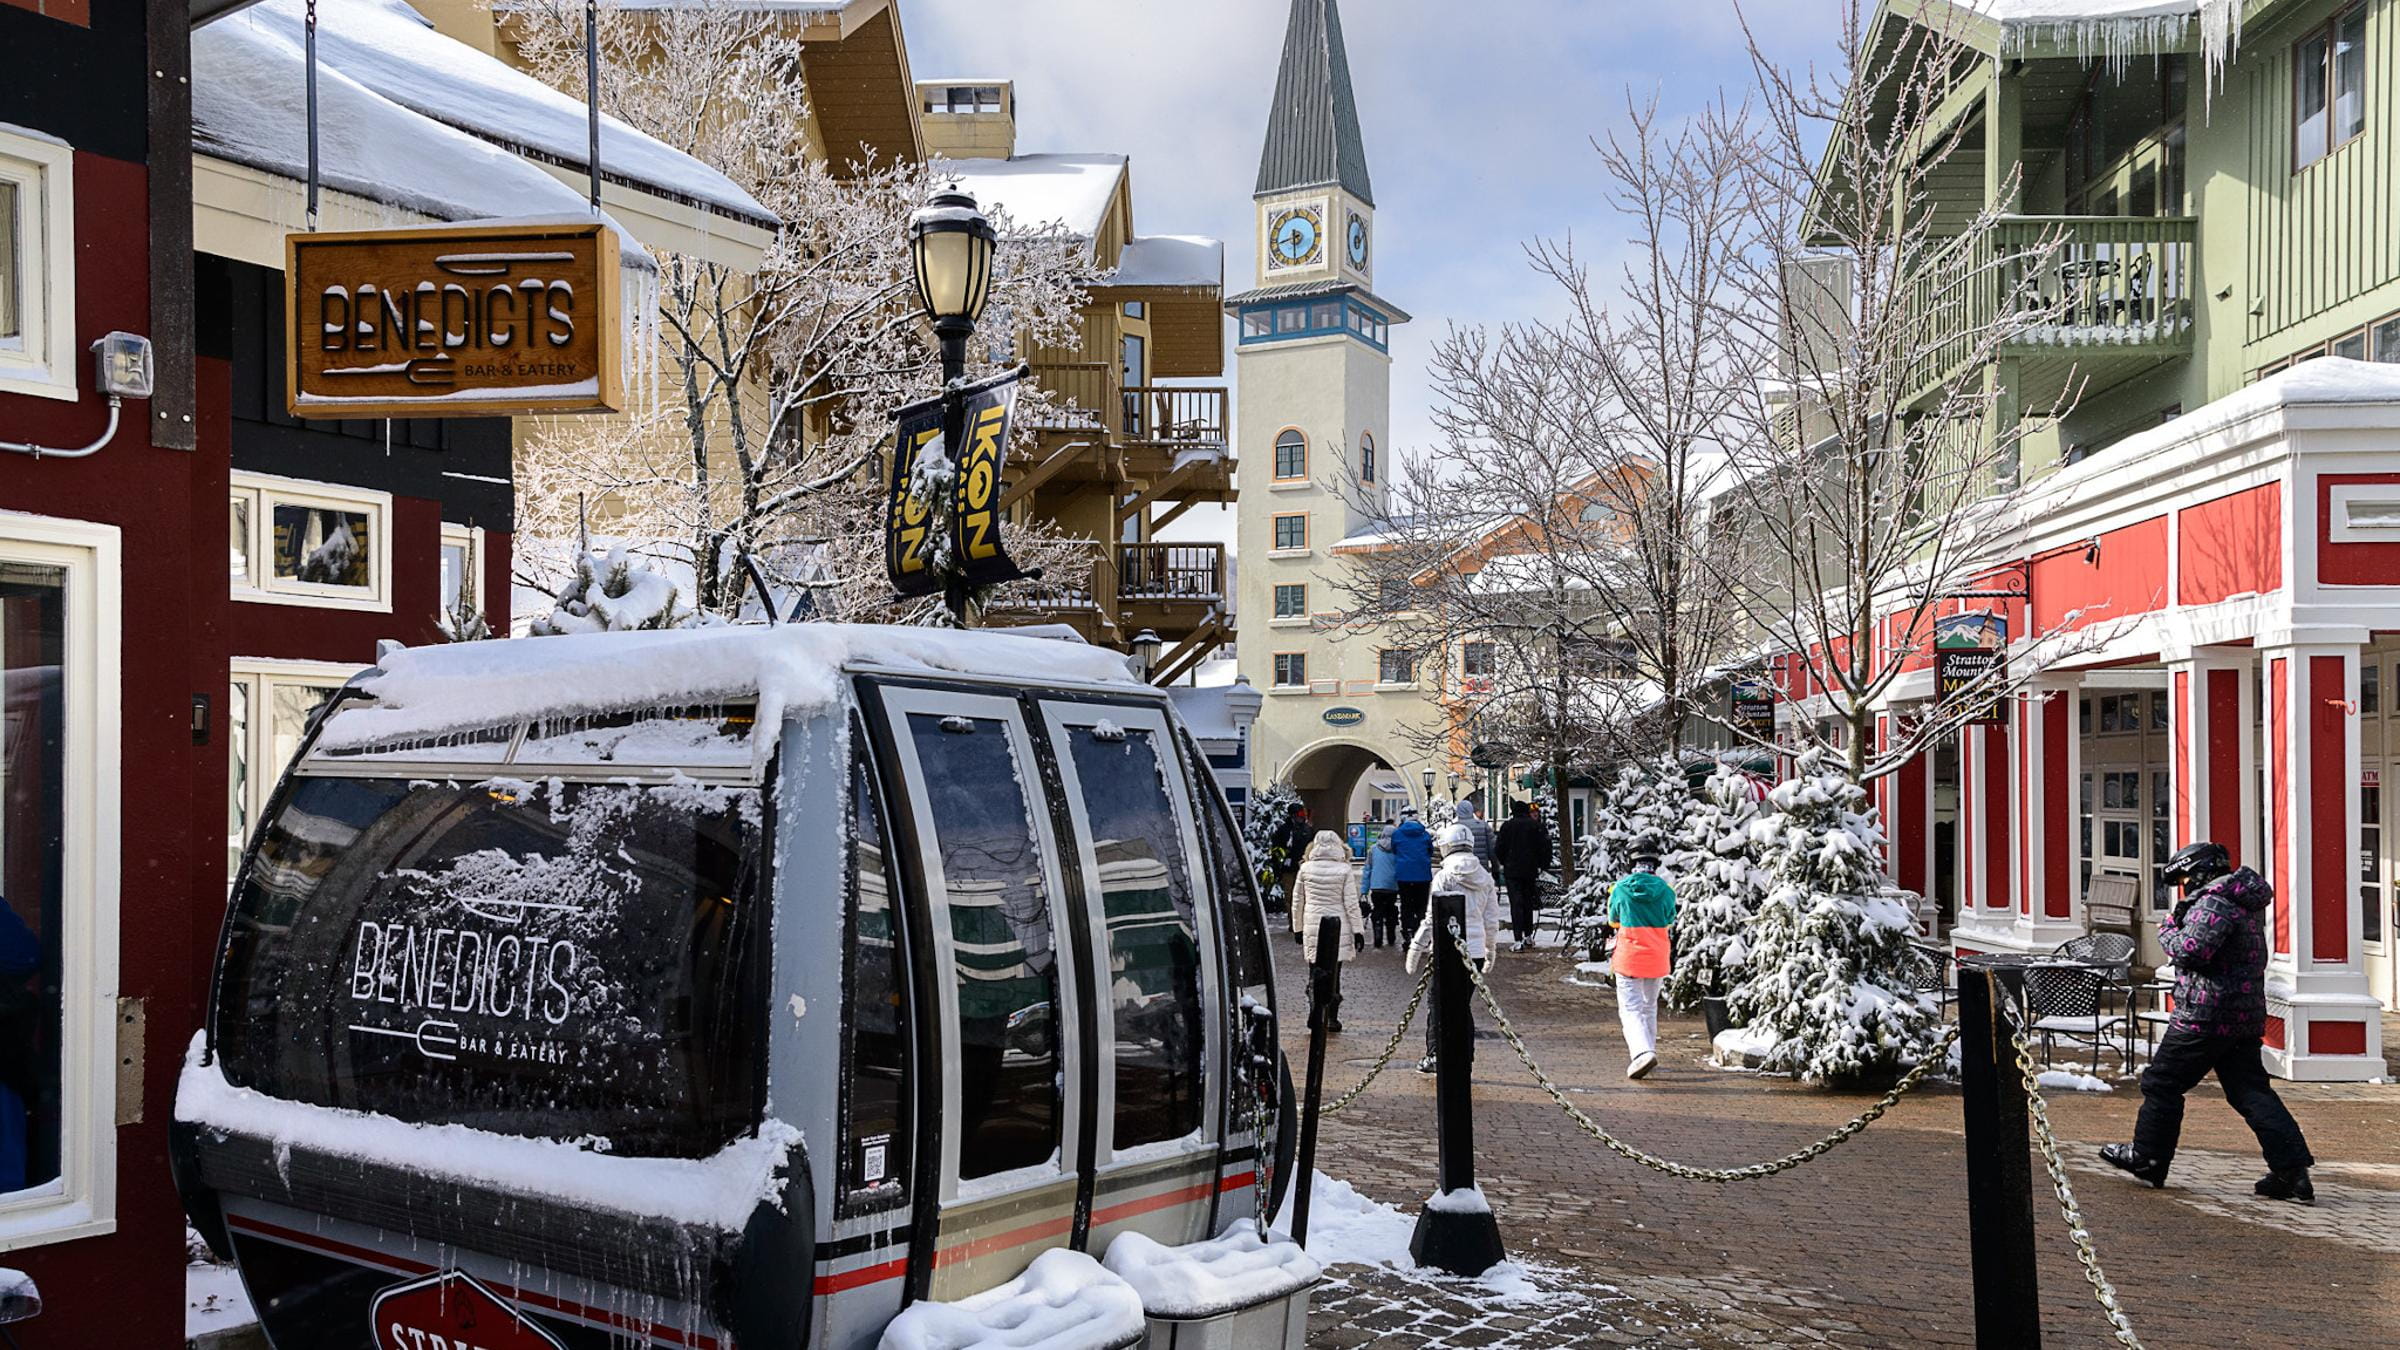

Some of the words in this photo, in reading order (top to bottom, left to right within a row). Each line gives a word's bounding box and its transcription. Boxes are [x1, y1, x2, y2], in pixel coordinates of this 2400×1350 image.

[321, 280, 574, 351] BENEDICTS
[464, 365, 496, 376] BAR
[502, 365, 513, 376] &
[518, 364, 577, 376] EATERY
[901, 428, 939, 573] ION
[958, 457, 970, 513] PASS
[966, 405, 1006, 560] IKON
[1942, 666, 1996, 677] Mount
[1326, 712, 1361, 721] LANDMARK
[2361, 771, 2379, 781] ATM
[351, 921, 576, 1025] BENEDICTS
[460, 1036, 487, 1054] BAR
[494, 1041, 503, 1056] &
[511, 1043, 569, 1065] EATERY
